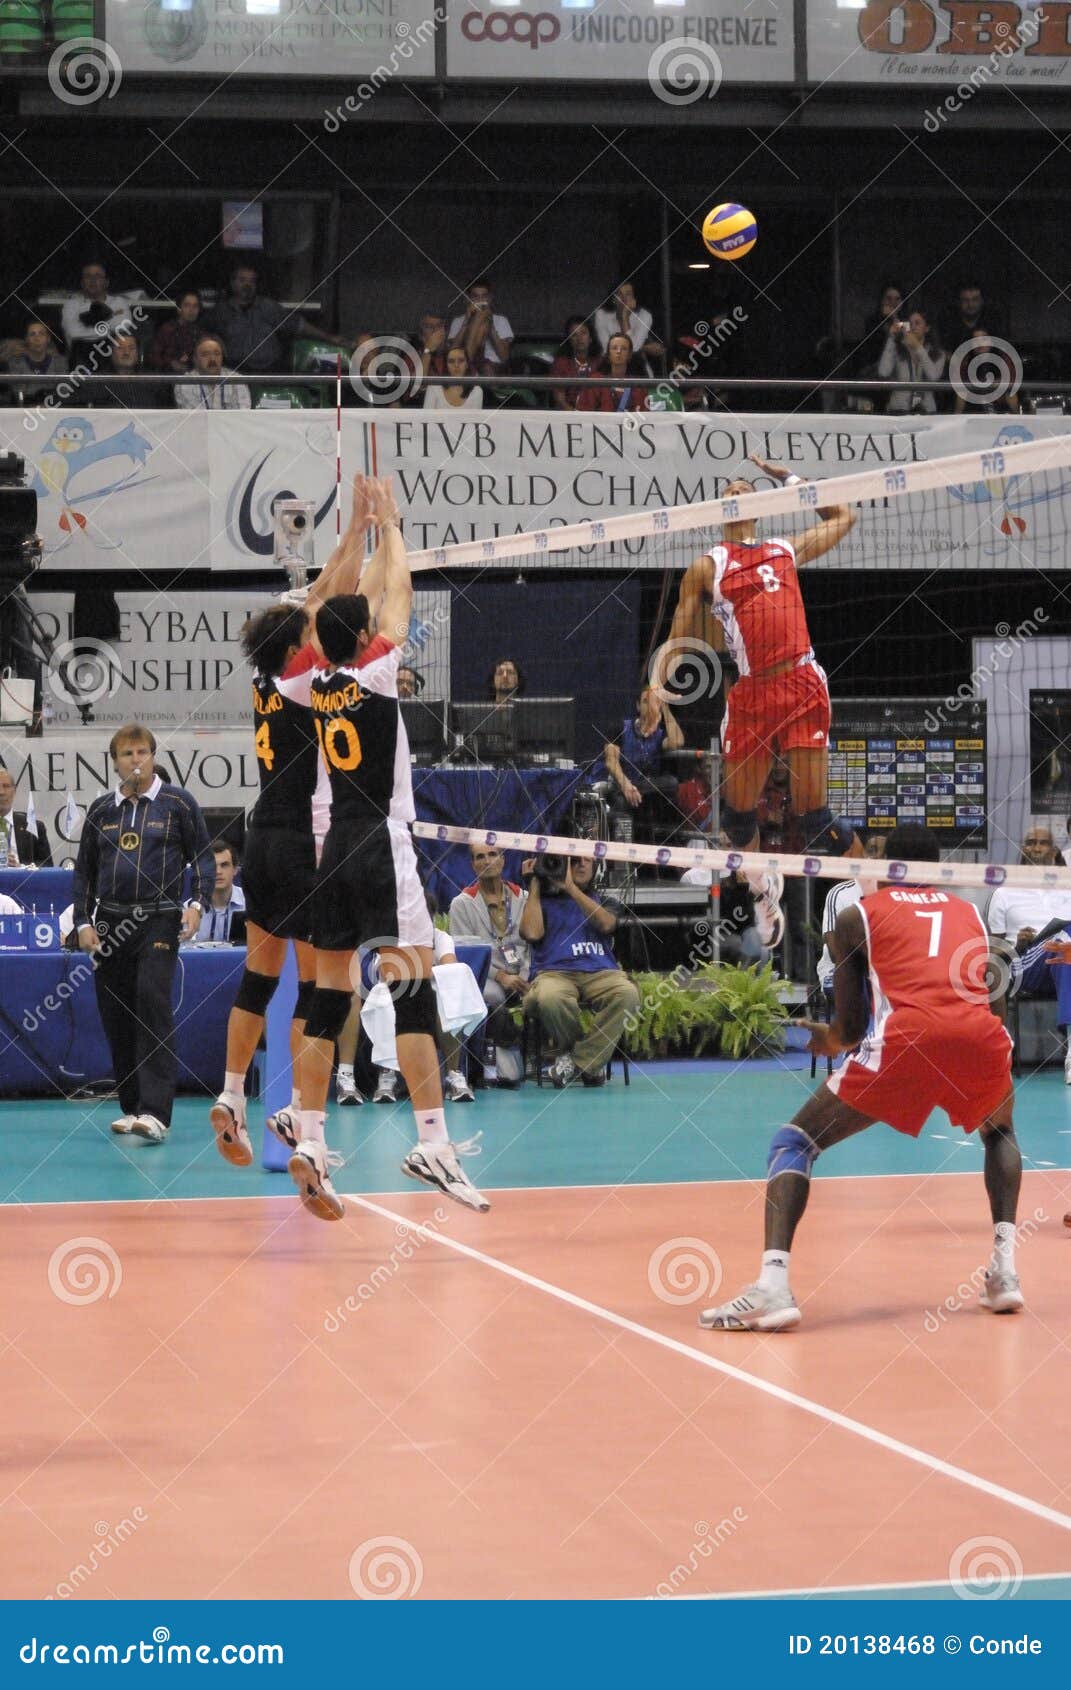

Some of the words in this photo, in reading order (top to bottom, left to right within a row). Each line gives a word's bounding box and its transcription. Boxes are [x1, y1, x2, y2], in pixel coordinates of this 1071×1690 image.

[214, 0, 401, 18] FODAZIONE
[461, 11, 561, 50] coop
[571, 14, 675, 45] UNICOOP
[683, 16, 778, 47] FIRENZE
[857, 0, 1071, 57] OBI
[722, 235, 744, 250] FIVB
[393, 421, 496, 459] FIVB
[517, 422, 657, 460] MEN'S
[675, 422, 929, 463] VOLLEYBALL
[397, 468, 558, 507] WORLD
[757, 564, 780, 592] 8
[33, 611, 253, 643] OLEYBAL
[35, 923, 54, 948] 9
[913, 910, 943, 958] 7
